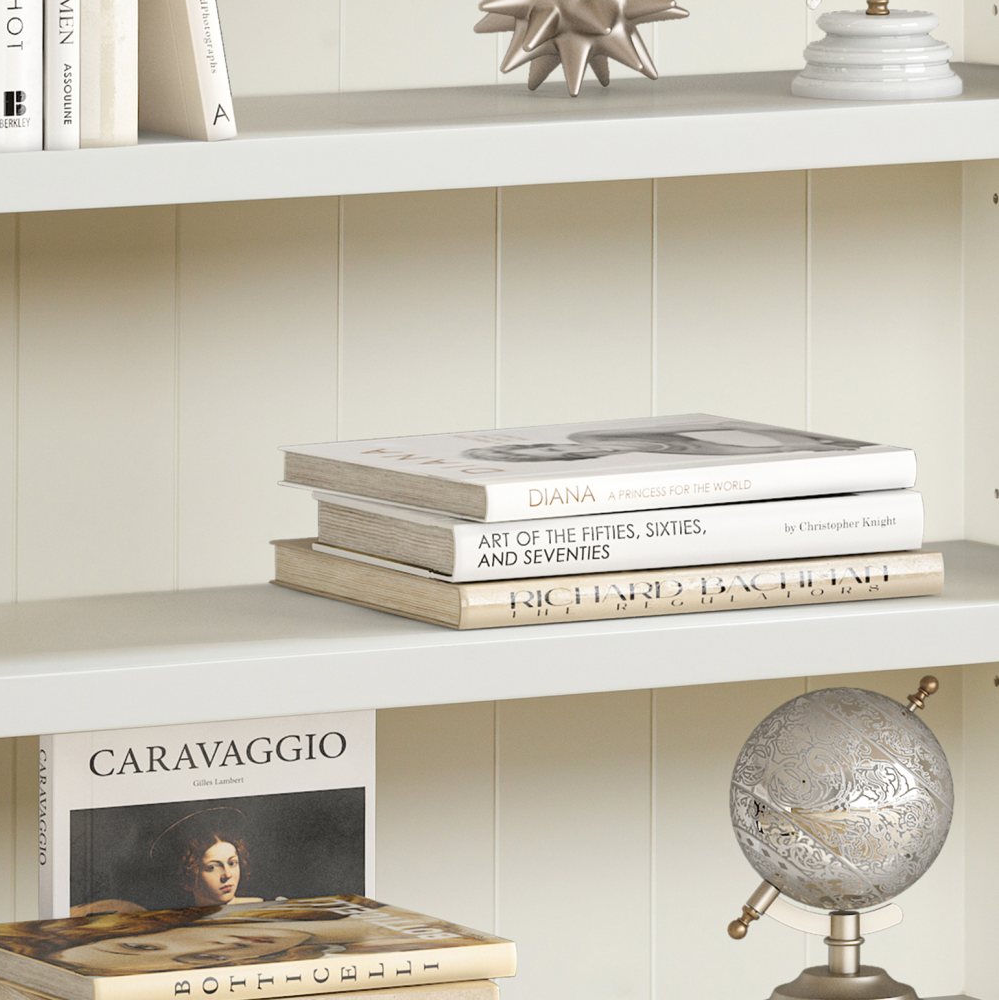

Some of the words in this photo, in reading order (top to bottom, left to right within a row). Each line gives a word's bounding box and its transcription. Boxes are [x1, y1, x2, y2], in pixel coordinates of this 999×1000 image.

[64, 63, 73, 126] ASSOULINE
[0, 118, 31, 129] BERKLEY
[212, 103, 231, 126] A
[529, 485, 596, 508] DIANA
[608, 491, 617, 501] A
[618, 486, 668, 500] PRINCESS
[669, 484, 691, 497] FOR
[693, 482, 711, 494] THE
[713, 480, 752, 493] WORLD
[478, 532, 510, 549] ART
[516, 530, 541, 547] OF
[545, 528, 576, 545] THE
[582, 523, 641, 541] FIFTIES,
[646, 519, 707, 537] SIXTIES,
[784, 522, 797, 535] by
[799, 519, 860, 531] Christopher
[862, 516, 897, 527] Knight
[478, 550, 518, 568] AND
[523, 544, 611, 565] SEVENTIES
[510, 579, 683, 610] RICHARD
[701, 565, 890, 595] BACHMAN
[88, 730, 348, 778] CARAVAGGIO
[192, 780, 213, 788] Gilles
[214, 777, 244, 786] Lambert
[39, 748, 47, 866] CARAVAGGIO
[174, 960, 440, 996] BOTTICELLI
